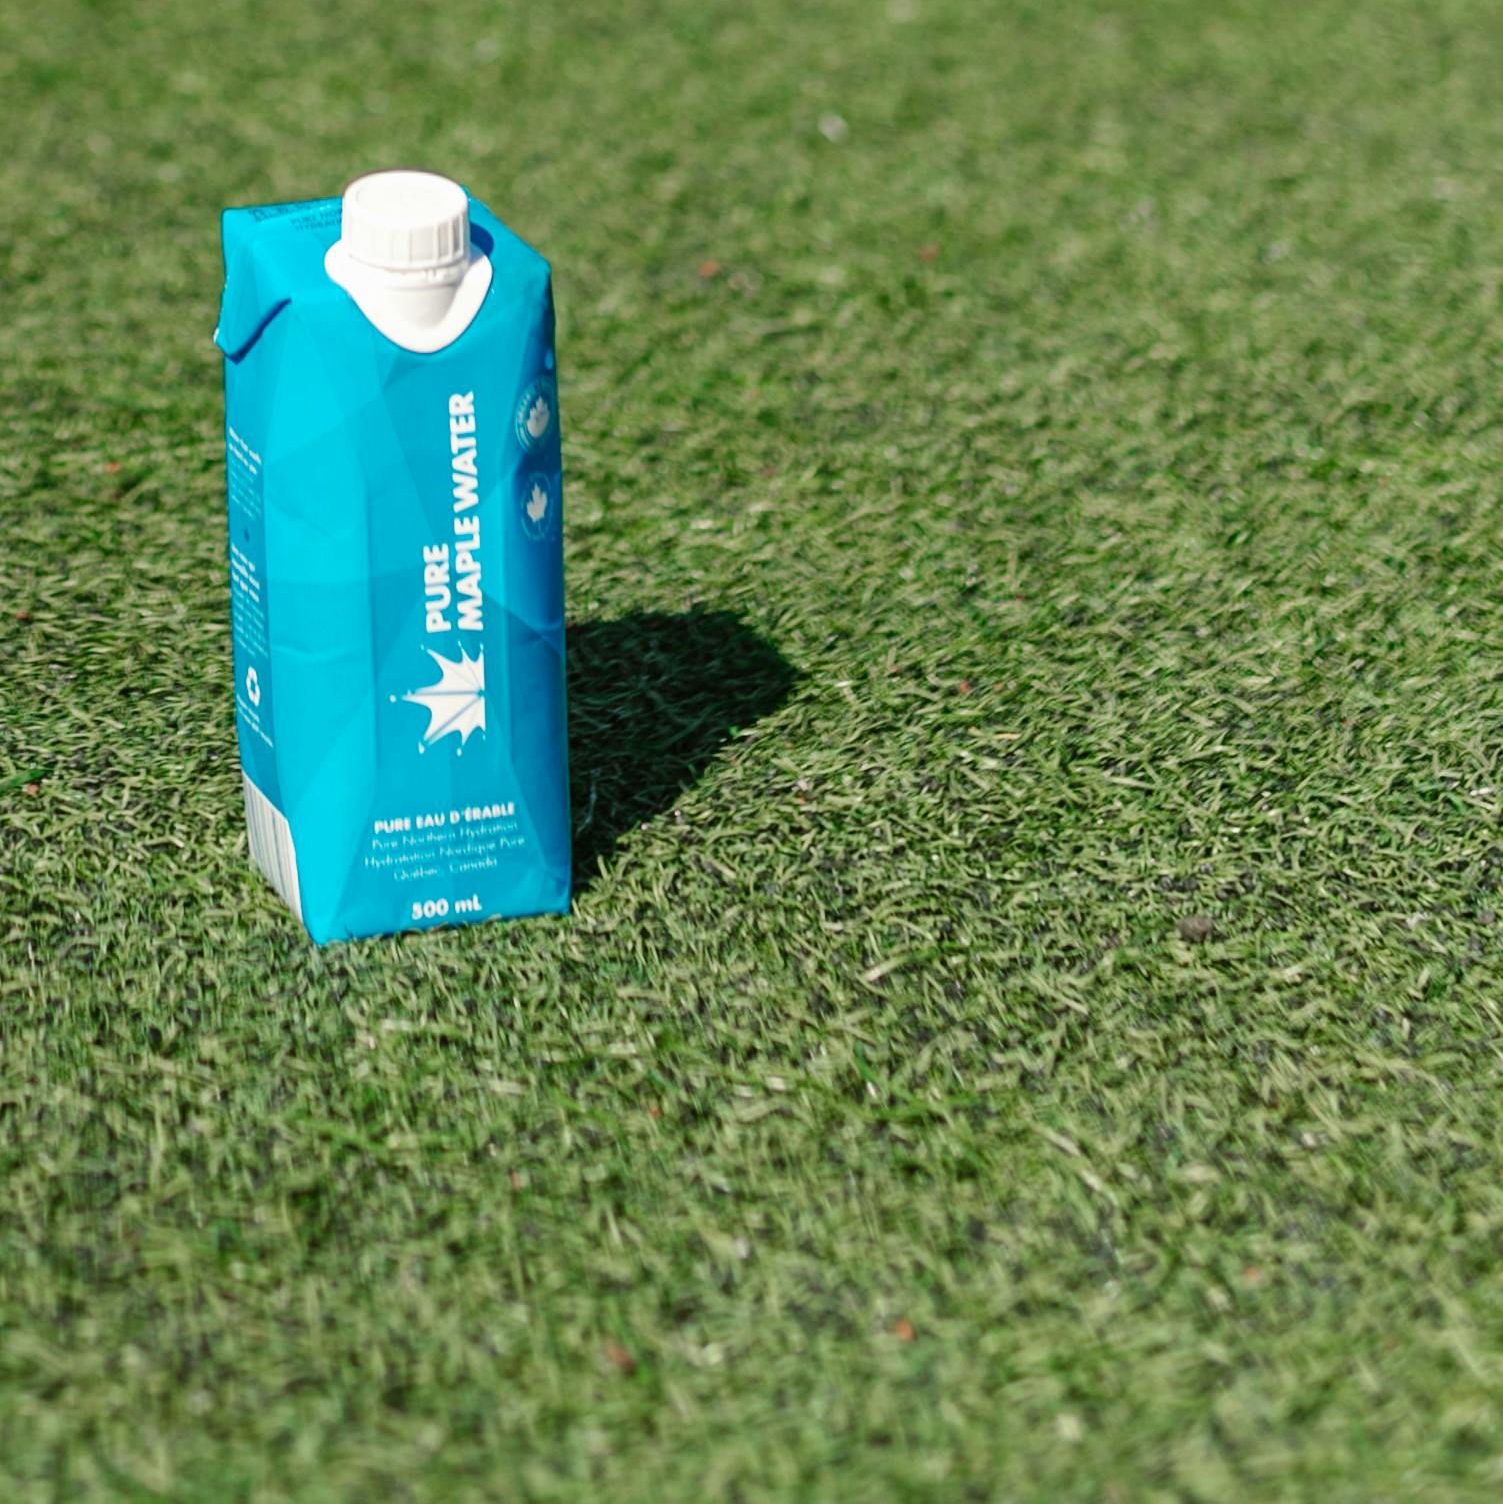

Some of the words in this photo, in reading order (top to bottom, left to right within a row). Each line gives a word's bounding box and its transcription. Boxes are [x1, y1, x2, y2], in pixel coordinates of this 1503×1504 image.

[449, 390, 480, 514] WATER
[423, 542, 452, 634] PURE
[454, 515, 484, 632] MAPLE
[374, 817, 411, 834] PURE
[416, 812, 445, 829] EAU
[412, 898, 449, 921] 500
[455, 893, 482, 914] mL
